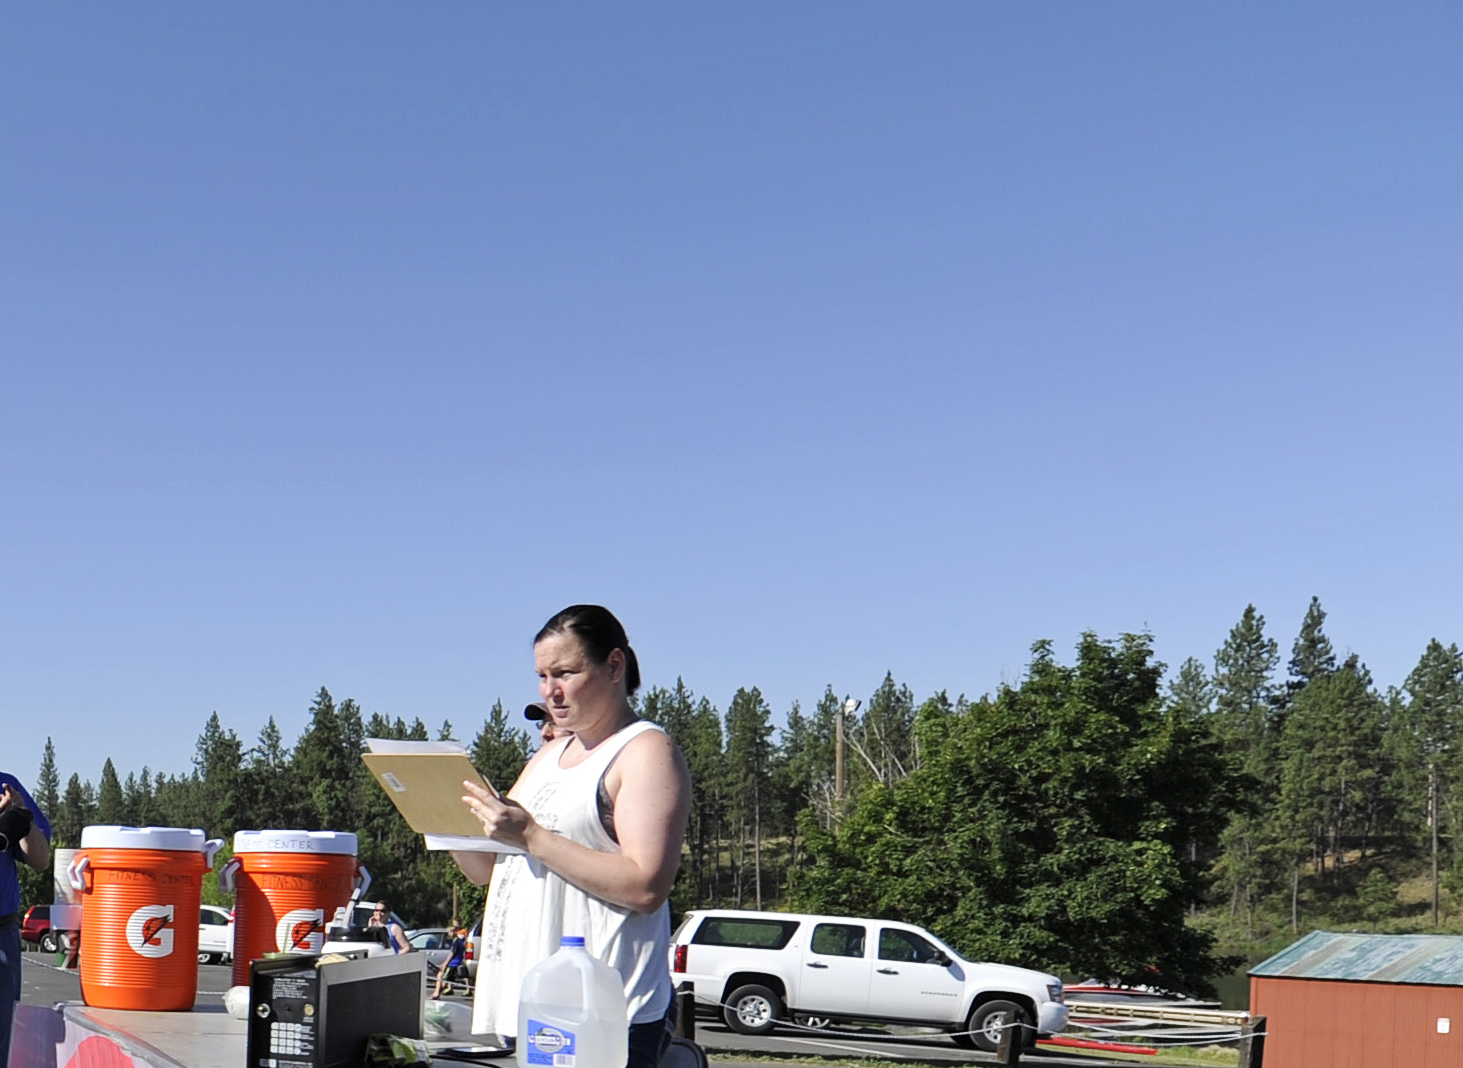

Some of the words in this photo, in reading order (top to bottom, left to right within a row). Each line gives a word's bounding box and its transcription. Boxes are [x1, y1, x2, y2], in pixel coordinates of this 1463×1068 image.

[267, 838, 314, 850] CENTER
[262, 874, 304, 889] FITNESS
[125, 905, 174, 958] G
[276, 908, 324, 956] G
